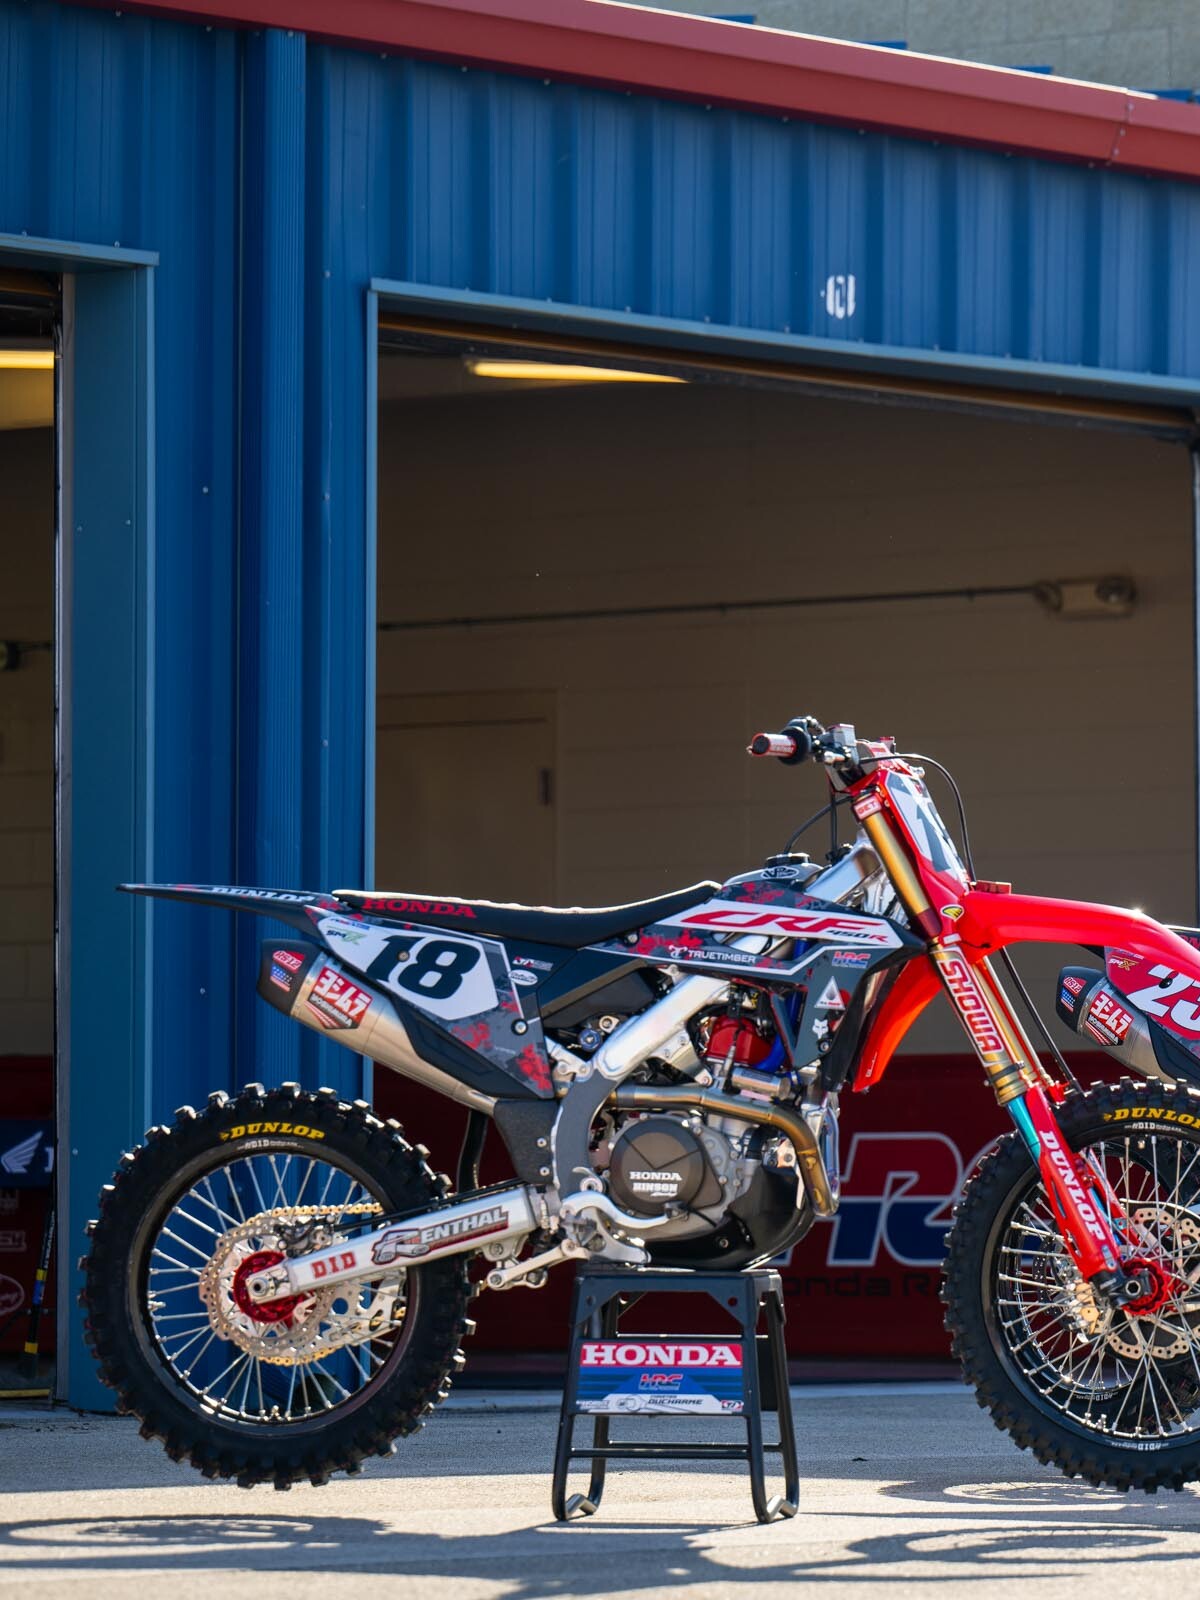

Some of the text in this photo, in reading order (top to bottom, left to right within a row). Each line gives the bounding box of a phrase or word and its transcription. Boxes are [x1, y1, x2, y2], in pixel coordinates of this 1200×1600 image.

[210, 886, 316, 902] DUNLOP
[361, 897, 478, 918] HONDA
[680, 911, 886, 933] CRF
[826, 929, 889, 943] 450R
[365, 934, 481, 999] 18
[687, 949, 757, 963] TRUETIMBER
[313, 969, 372, 1017] ヨシムラ
[938, 959, 1003, 1053] SHOWA
[1090, 993, 1133, 1035] ヨシムラ
[230, 1121, 326, 1140] DUNLOP
[629, 1171, 682, 1181] HONDA
[1039, 1130, 1105, 1241] DUNLOP
[582, 1344, 742, 1366] HONDA
[640, 1373, 684, 1387] HRC
